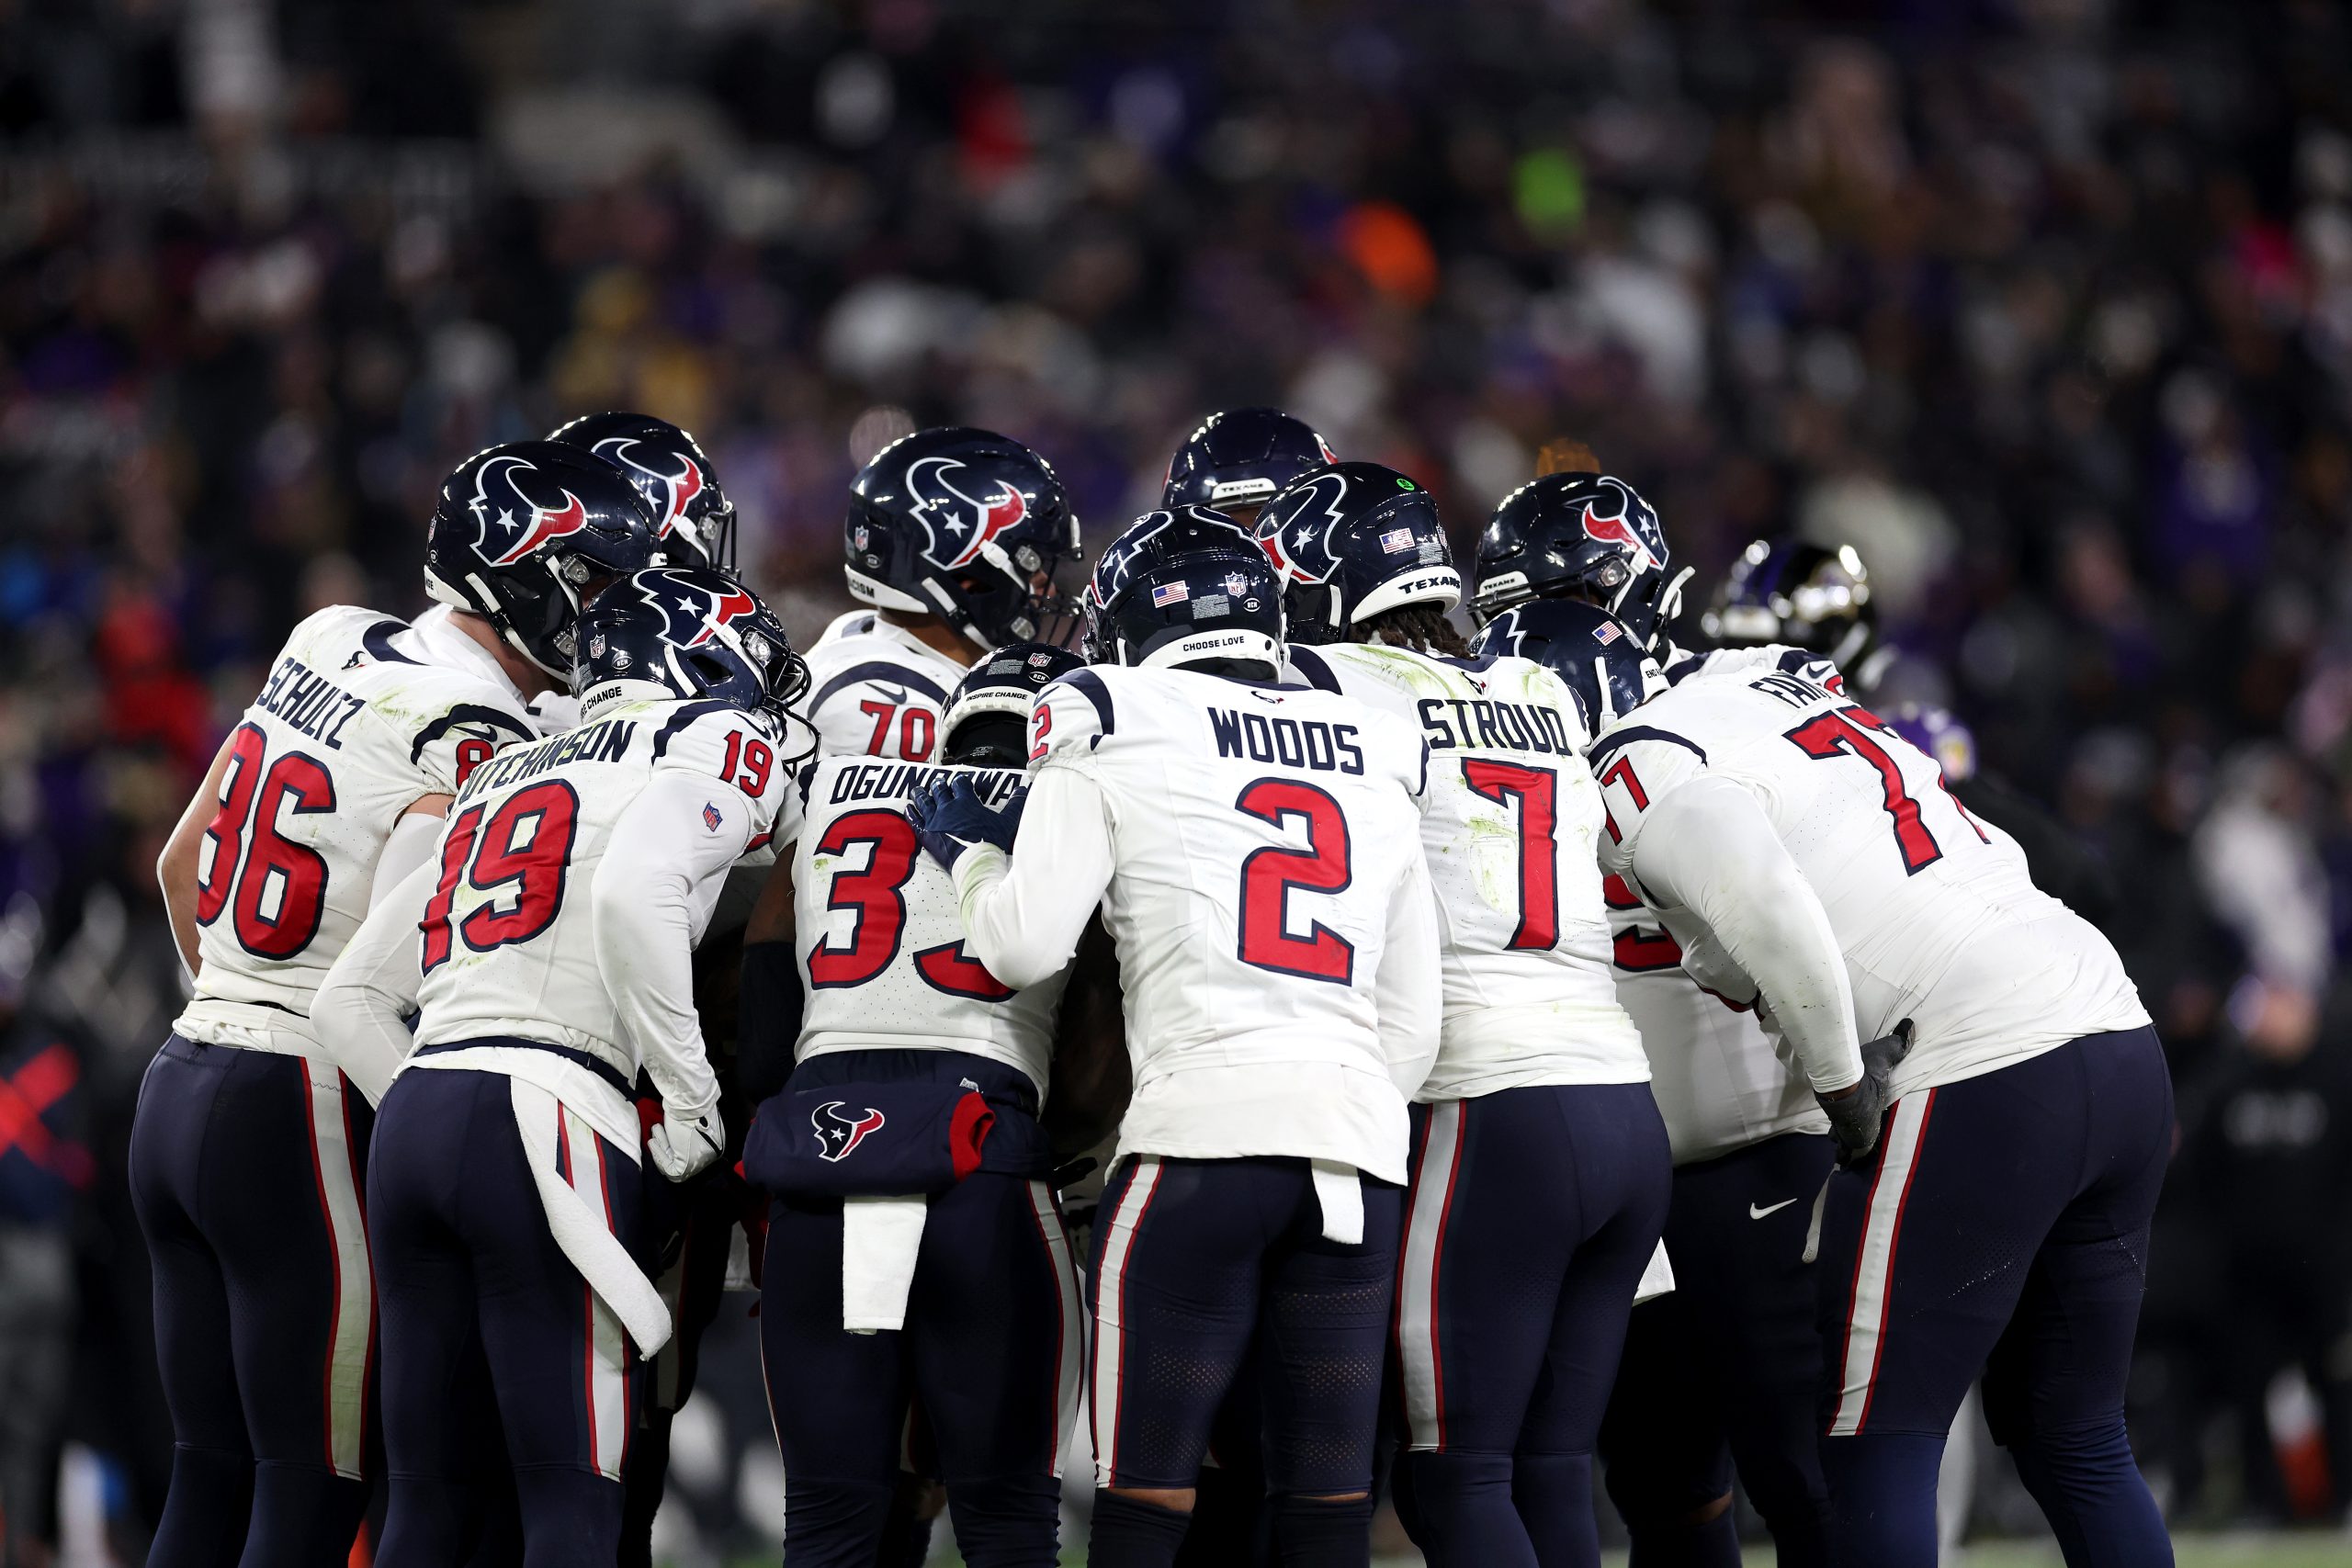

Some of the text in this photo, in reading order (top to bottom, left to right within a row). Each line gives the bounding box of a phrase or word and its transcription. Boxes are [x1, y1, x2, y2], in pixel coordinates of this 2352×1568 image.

[1221, 483, 1264, 493] TEXANS
[1230, 583, 1245, 595] NFL
[1397, 575, 1461, 595] TEXANS
[1483, 578, 1516, 592] TEXANS
[591, 642, 605, 655] NFL
[1030, 656, 1046, 665] NFL
[1182, 636, 1245, 652] CHOOSE LOVE
[256, 656, 368, 751] SCHULTZ
[587, 686, 623, 710] CHANGE
[966, 691, 1028, 703] INSPIRE CHANGE
[859, 698, 936, 763] 70
[1028, 703, 1052, 764] 2
[1206, 706, 1365, 776] WOODS
[1418, 698, 1573, 757] STROUD
[456, 738, 521, 792] 8
[458, 719, 638, 806] UTCHINSON
[718, 728, 774, 799] 19
[196, 720, 337, 961] 86
[1460, 756, 1561, 952] 7
[417, 778, 581, 978] 19
[807, 807, 1020, 1003] 3
[1235, 776, 1355, 987] 2
